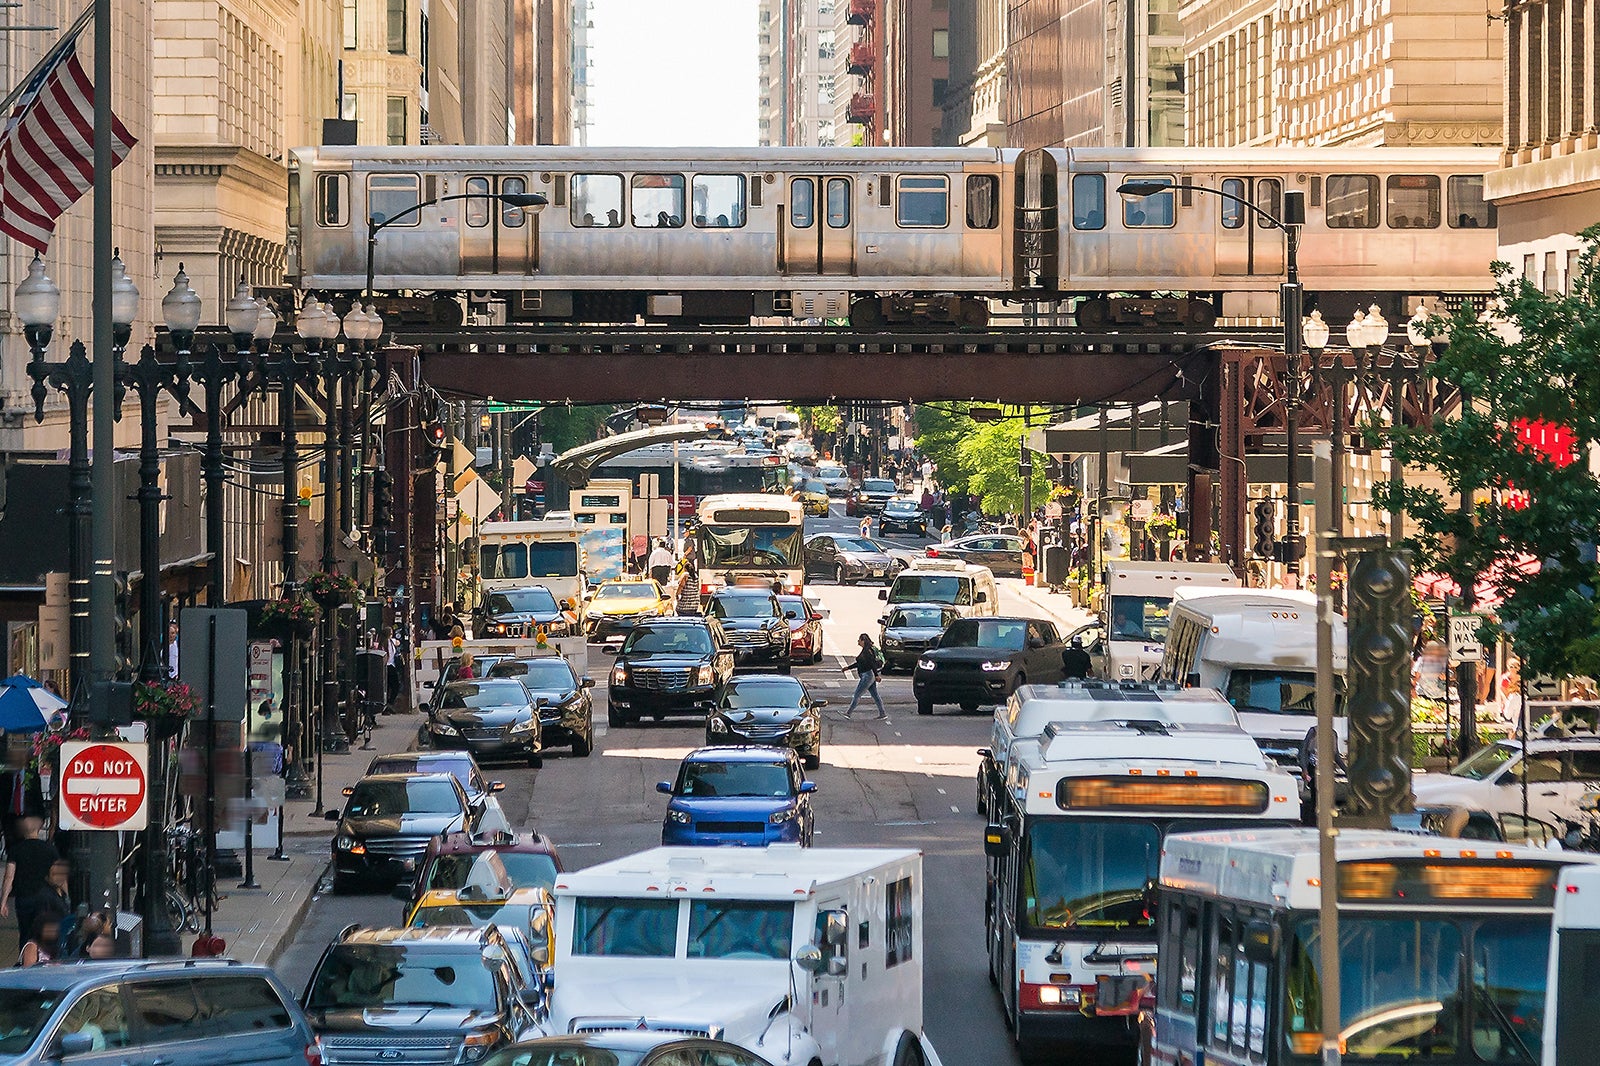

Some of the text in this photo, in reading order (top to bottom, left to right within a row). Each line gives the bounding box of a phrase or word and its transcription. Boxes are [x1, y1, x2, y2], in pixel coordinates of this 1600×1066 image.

[1454, 620, 1477, 632] ONE
[1453, 633, 1478, 644] WAY
[73, 759, 134, 775] DO NOT
[79, 796, 127, 813] ENTER
